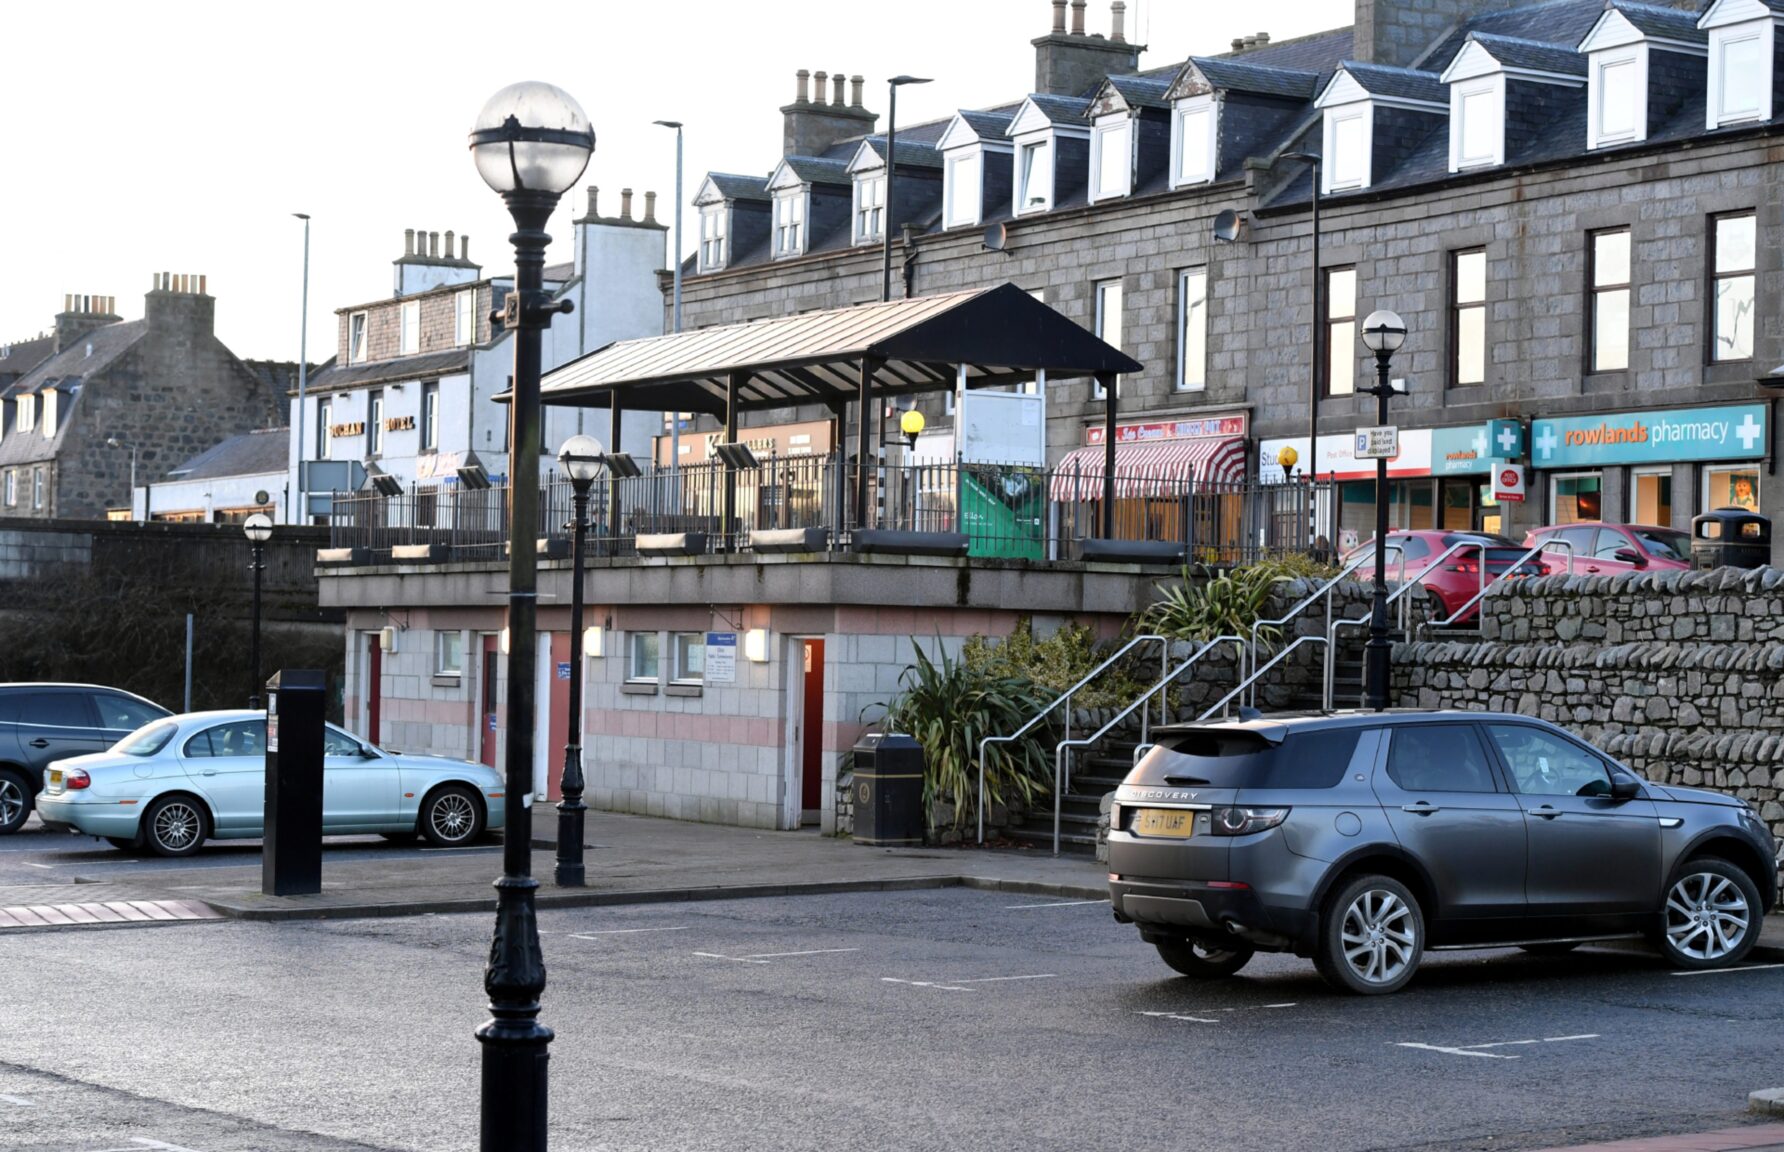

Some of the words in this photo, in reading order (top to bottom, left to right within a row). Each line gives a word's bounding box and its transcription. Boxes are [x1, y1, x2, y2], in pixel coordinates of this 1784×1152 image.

[383, 416, 415, 432] HOTEL
[1565, 421, 1648, 446] rowlands
[1652, 419, 1729, 448] pharmacy
[1445, 461, 1472, 471] pharmacy
[1130, 791, 1198, 799] DISCOVERY
